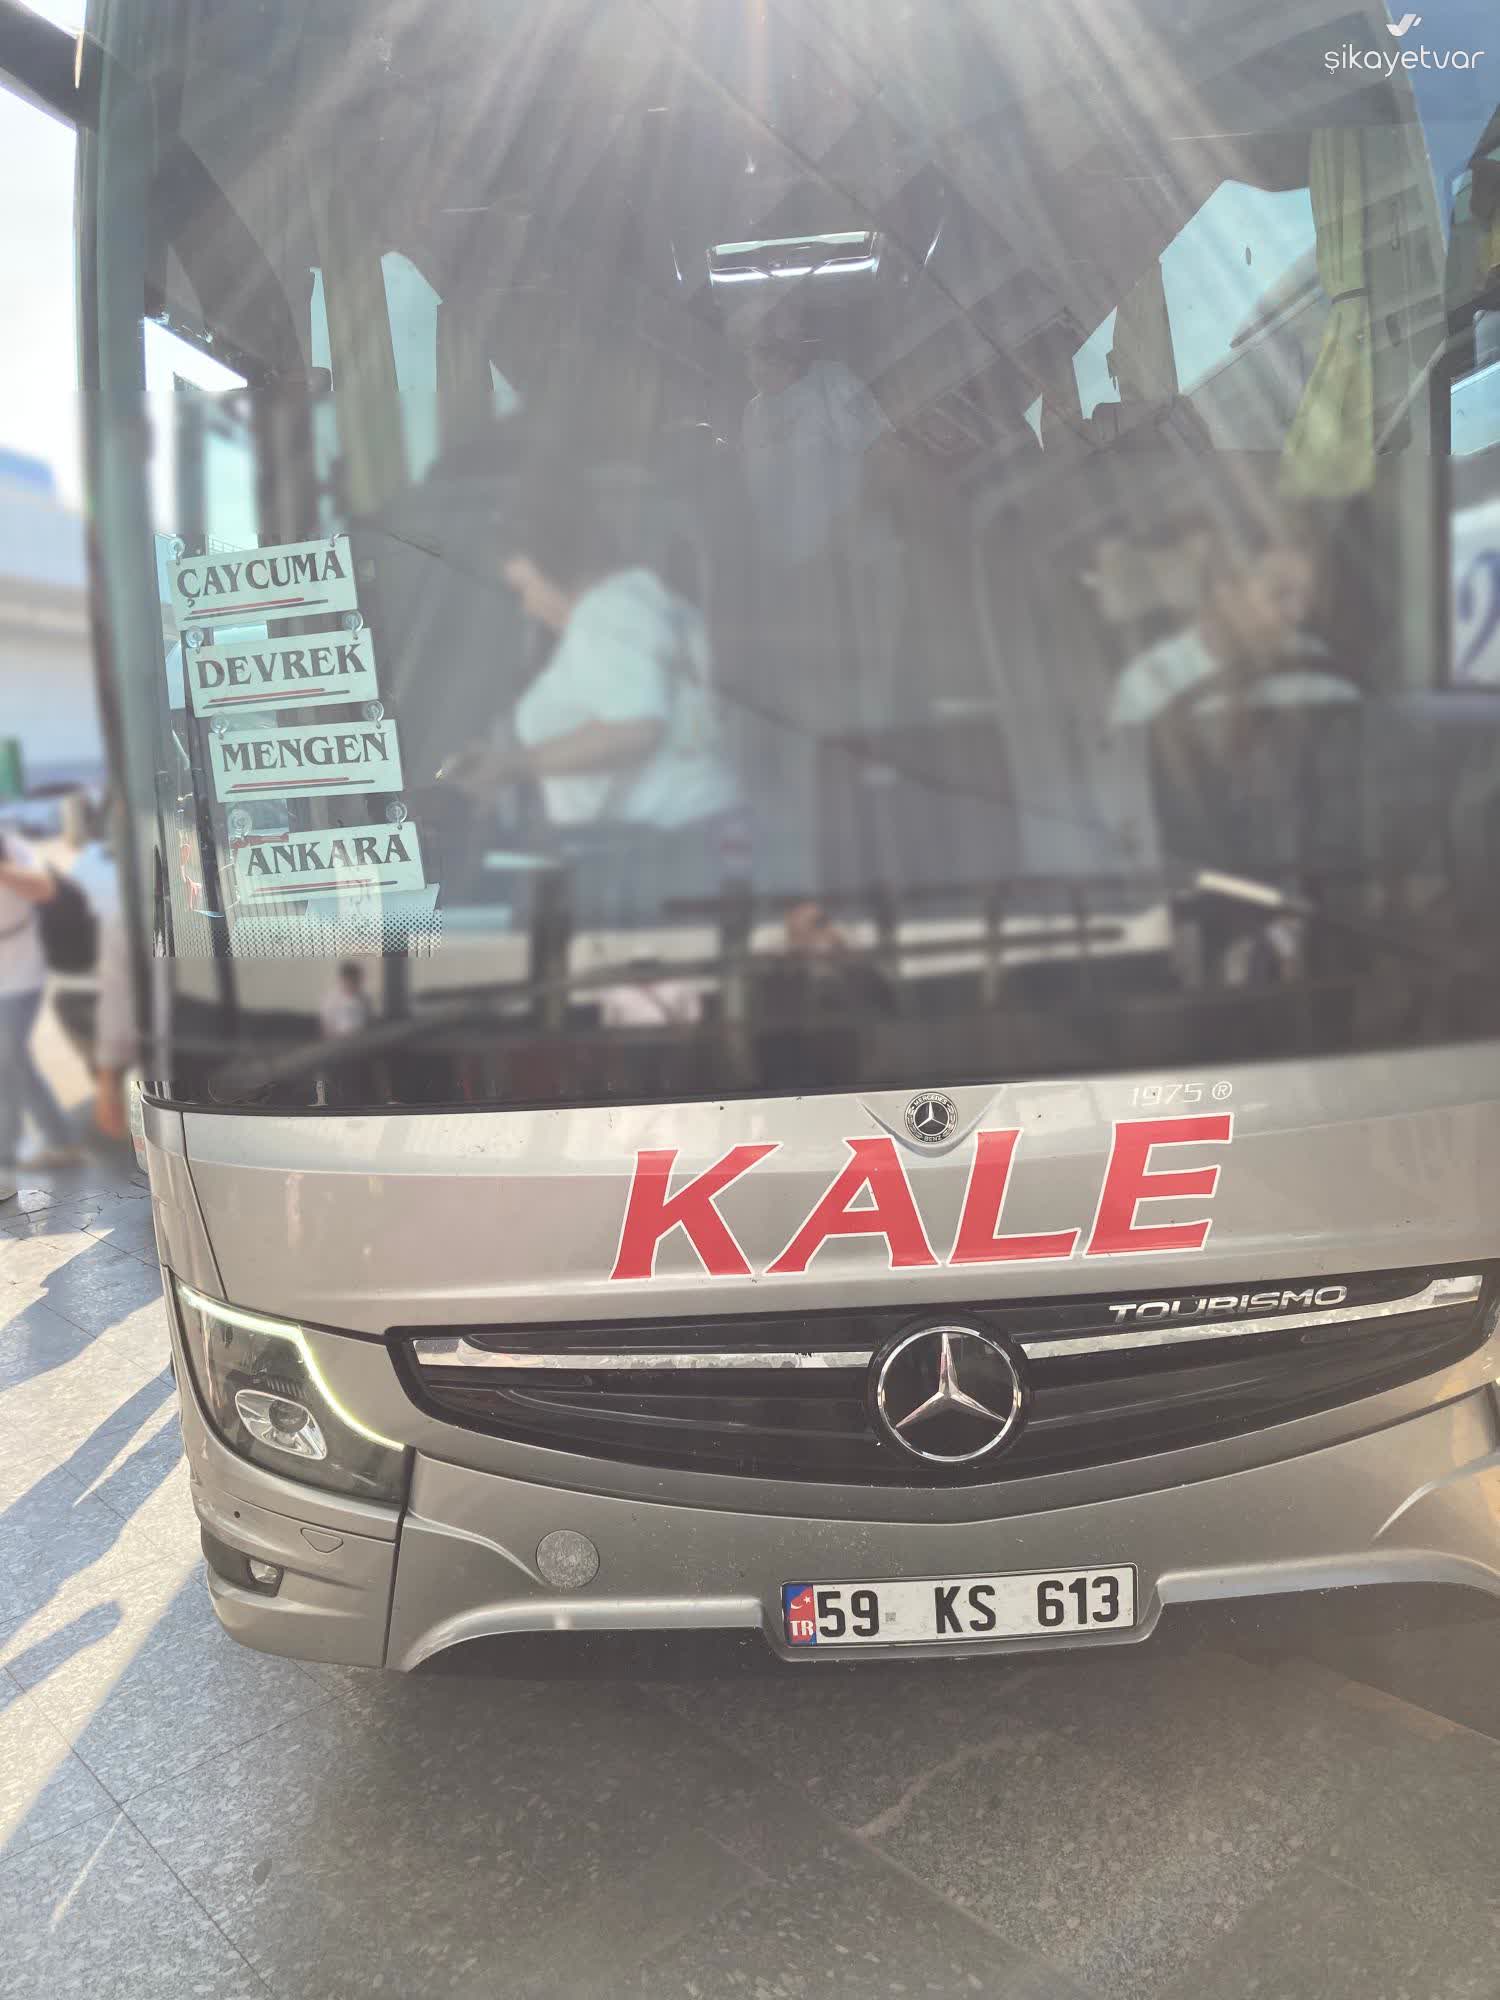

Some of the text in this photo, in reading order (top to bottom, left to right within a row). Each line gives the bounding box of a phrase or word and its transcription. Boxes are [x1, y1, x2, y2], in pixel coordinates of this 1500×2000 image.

[177, 550, 346, 608] ÇAYCUMA
[196, 644, 367, 689] DEVREK
[221, 731, 389, 772] MENGEN
[247, 832, 411, 876] ANKARA
[608, 1112, 1235, 1281] KALE
[1109, 1285, 1347, 1324] TOURISMO
[791, 1619, 814, 1637] TR
[816, 1575, 1119, 1638] 59 KS 613
